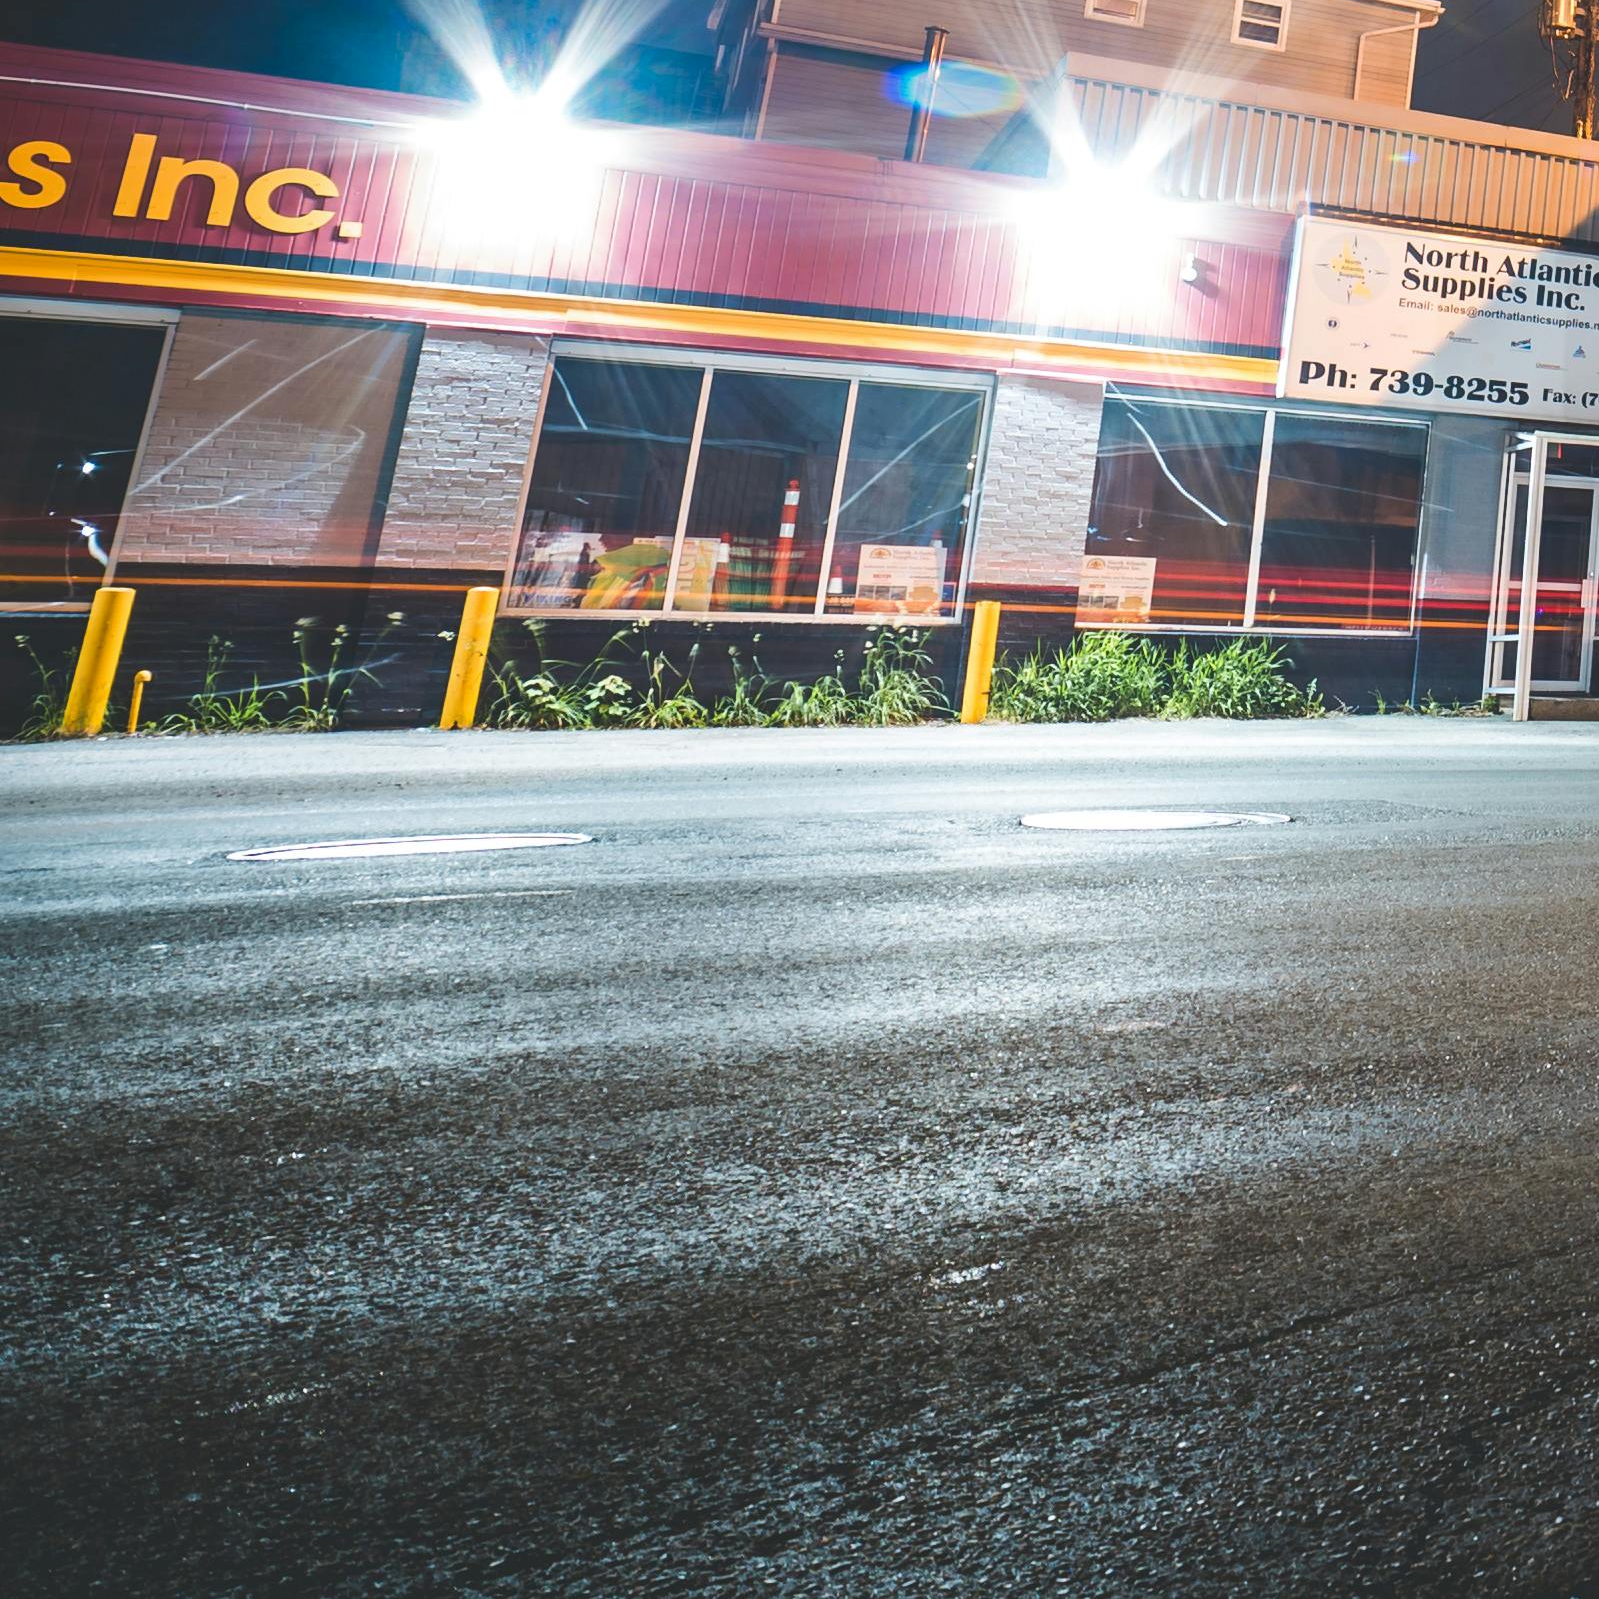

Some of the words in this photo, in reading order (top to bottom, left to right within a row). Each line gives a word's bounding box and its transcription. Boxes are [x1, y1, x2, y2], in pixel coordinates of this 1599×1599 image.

[113, 134, 363, 239] Inc.
[1405, 241, 1489, 273] North
[1399, 298, 1434, 312] Email:
[1401, 267, 1528, 305] Supplies
[1535, 284, 1586, 311] Inc.
[1299, 360, 1358, 389] Ph:
[1369, 367, 1530, 406] 739-8255
[1542, 388, 1576, 405] Fax:
